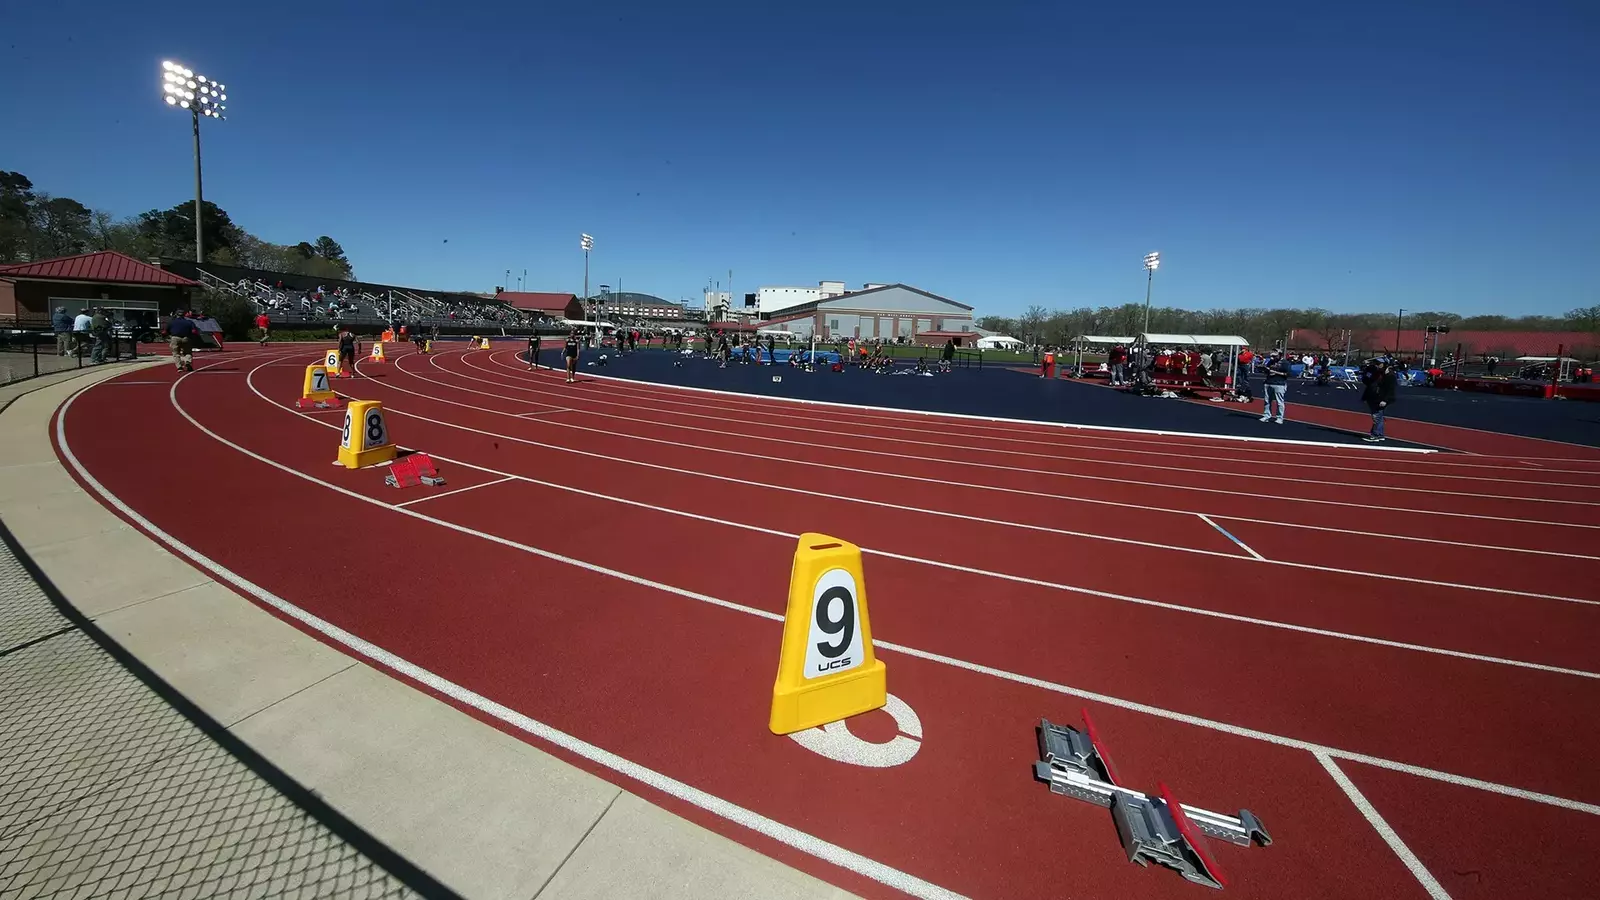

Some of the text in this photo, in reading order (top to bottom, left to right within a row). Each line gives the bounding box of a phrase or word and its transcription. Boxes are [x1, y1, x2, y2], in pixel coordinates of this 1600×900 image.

[374, 346, 380, 355] 5
[328, 354, 336, 366] 6
[314, 373, 325, 388] 7
[343, 414, 351, 442] 8
[367, 414, 383, 441] 8
[815, 586, 855, 659] 9
[818, 657, 851, 671] UCS
